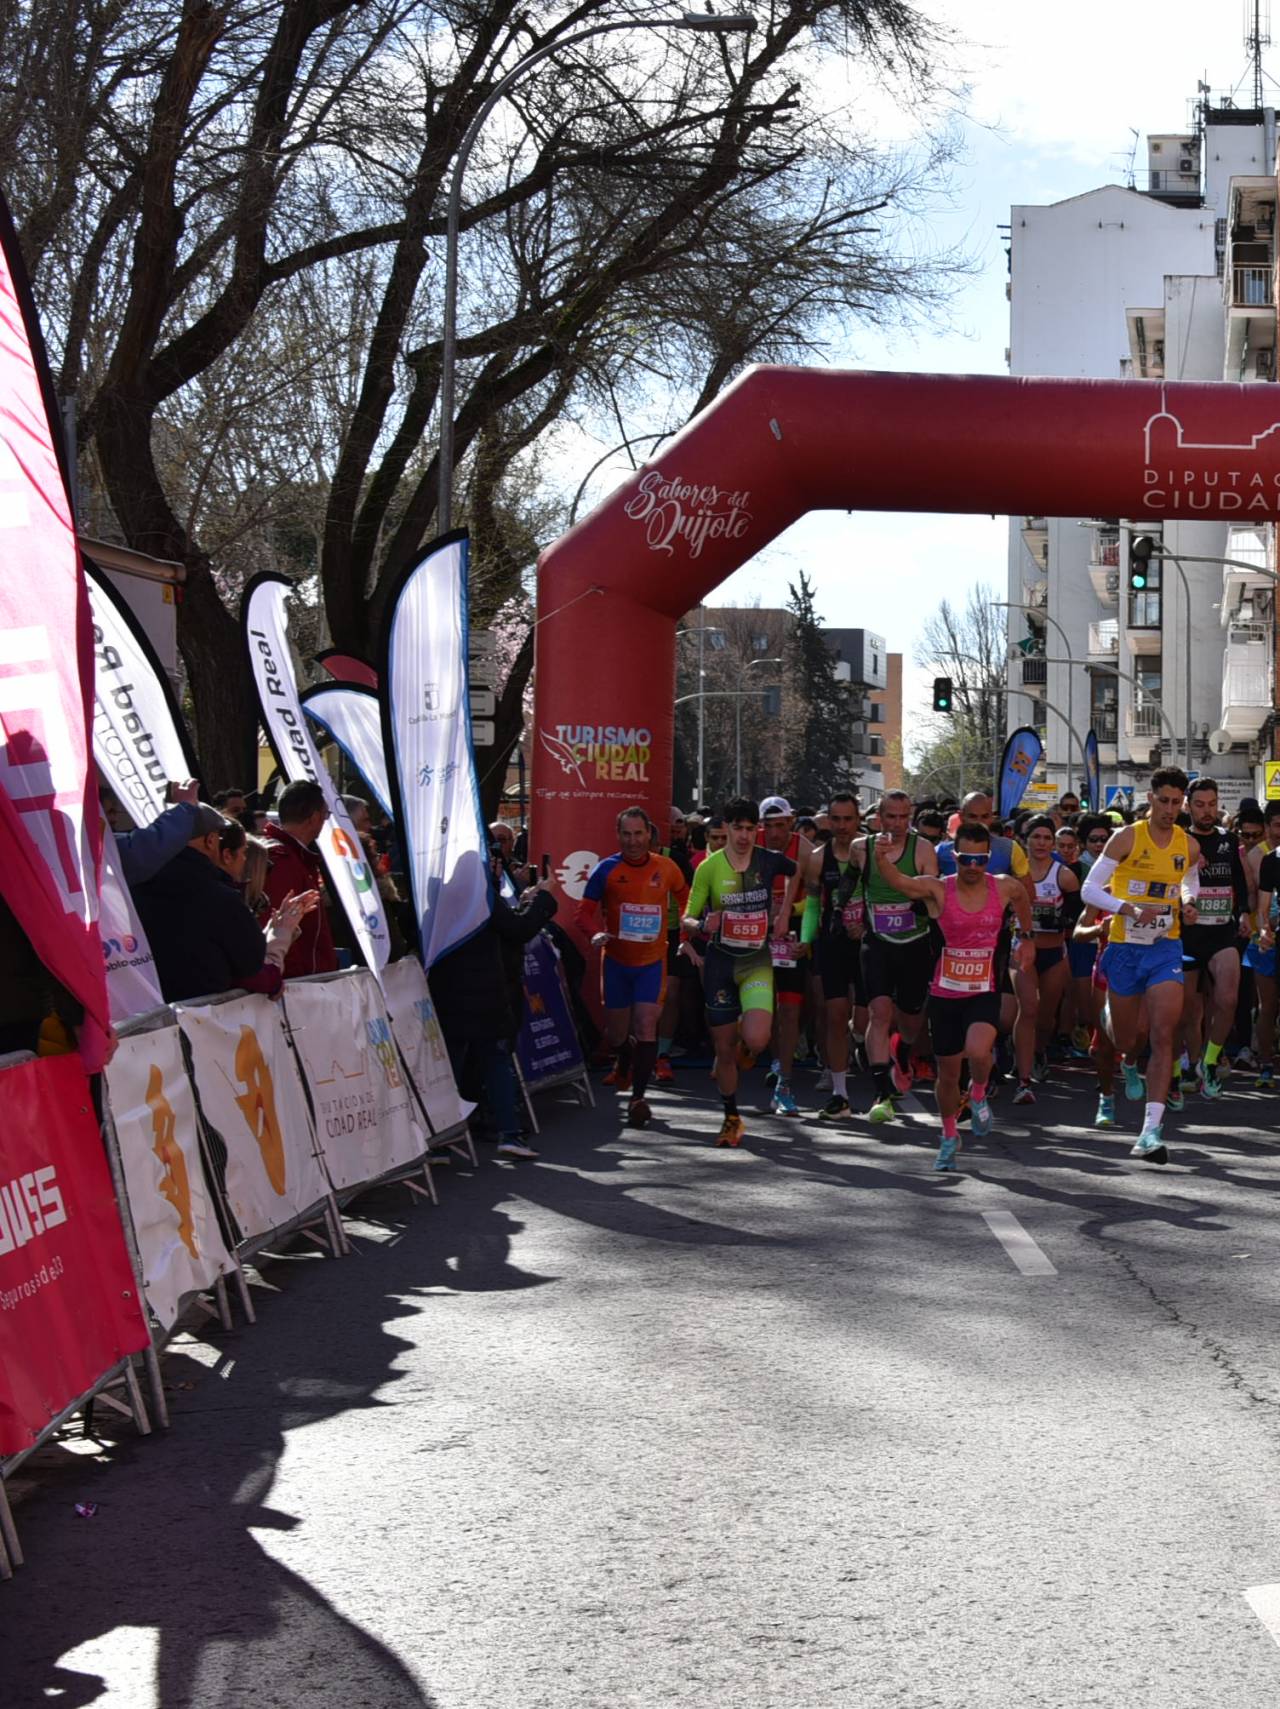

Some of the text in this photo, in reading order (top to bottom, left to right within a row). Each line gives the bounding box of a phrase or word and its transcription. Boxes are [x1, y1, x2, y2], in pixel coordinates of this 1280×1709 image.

[624, 471, 751, 520] Sabores del
[645, 500, 753, 559] Quijote
[251, 630, 287, 698] Real
[555, 725, 652, 746] TURISMO
[572, 743, 651, 763] CIUDAD
[595, 762, 650, 782] REAL
[1200, 899, 1227, 911] 1382
[628, 916, 654, 928] 1212
[733, 924, 759, 935] 659
[887, 916, 903, 927] 70
[950, 961, 984, 976] 1009
